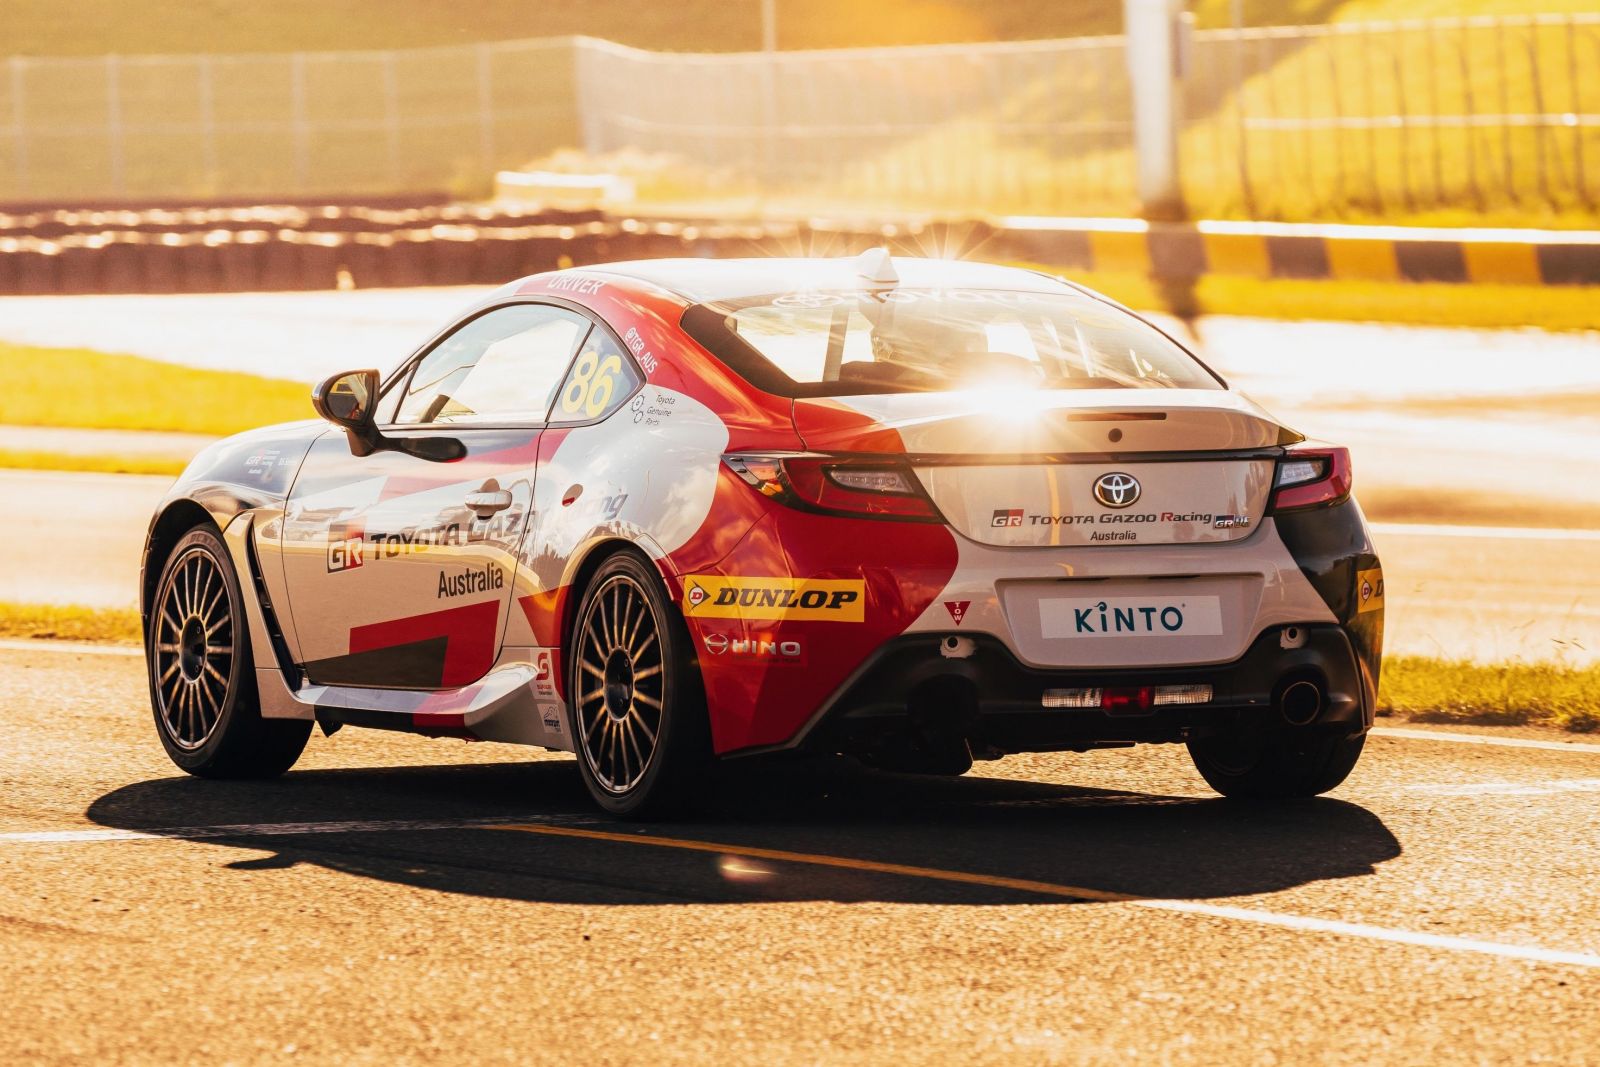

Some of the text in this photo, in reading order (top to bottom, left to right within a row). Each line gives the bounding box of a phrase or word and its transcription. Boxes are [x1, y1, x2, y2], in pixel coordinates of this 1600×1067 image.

[547, 275, 608, 296] DRIVER
[624, 327, 658, 374] @TGR_AUS
[562, 351, 622, 418] 86
[656, 394, 676, 405] Toyota
[993, 510, 1212, 527] GR TOYOTA GAZOO Racing
[328, 535, 365, 570] GR
[371, 522, 461, 561] TOYOTA
[1090, 530, 1137, 541] Australia
[438, 562, 504, 600] Australia
[713, 587, 858, 609] DUNLOP
[731, 638, 801, 656] HINO
